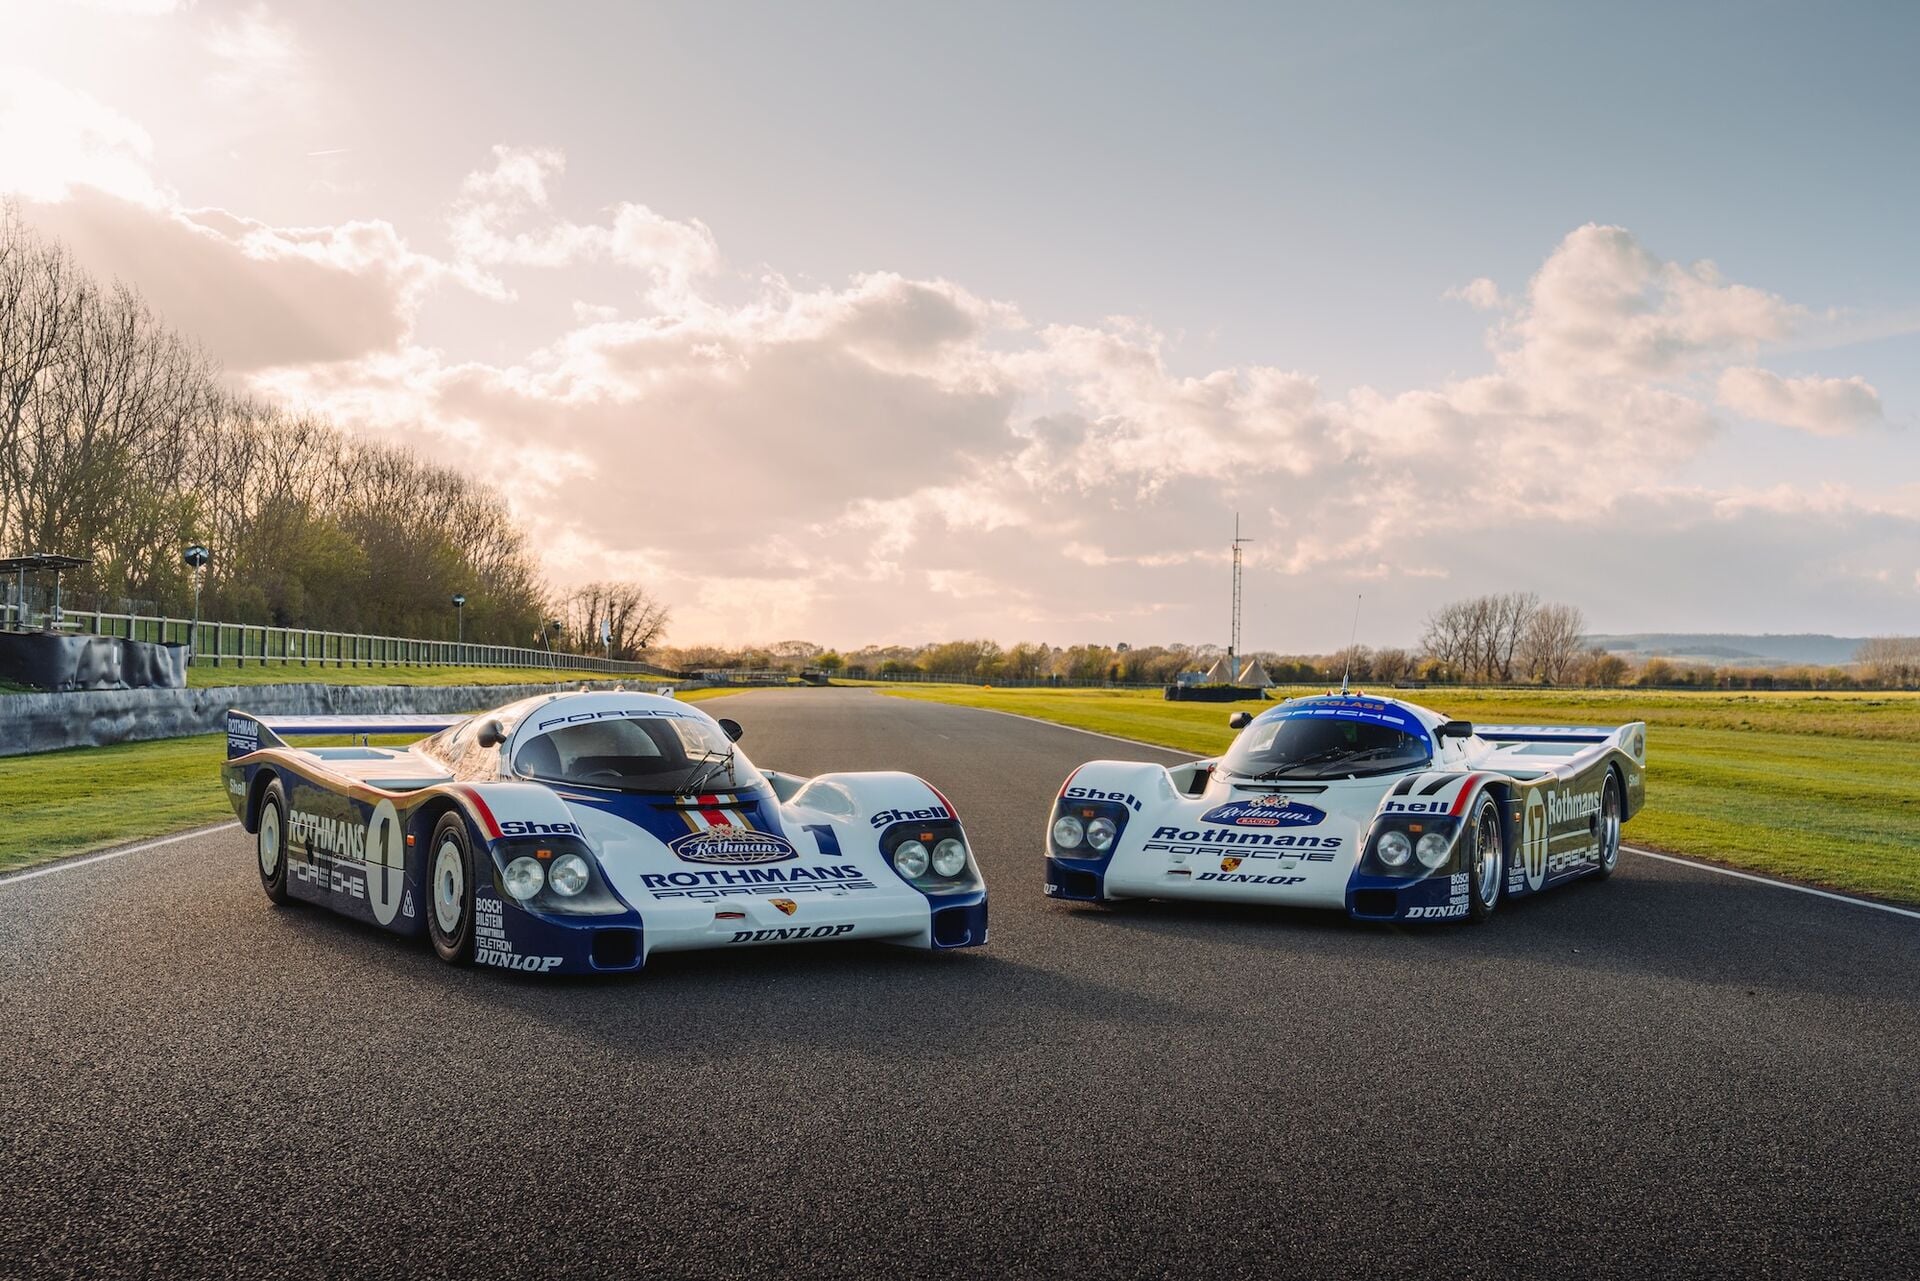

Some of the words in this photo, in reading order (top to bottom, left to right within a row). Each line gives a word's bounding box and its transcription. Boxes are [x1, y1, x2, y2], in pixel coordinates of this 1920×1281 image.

[228, 718, 258, 737] ROTHMANS
[539, 710, 709, 731] PORSCH
[228, 737, 257, 751] PORSCHE
[229, 778, 246, 796] Shell
[1067, 787, 1142, 812] Shell
[1385, 801, 1449, 813] hell
[1547, 787, 1600, 825] Rothmans
[870, 807, 950, 828] Shell
[1211, 806, 1312, 823] Rothmans
[289, 810, 365, 859] ROTHMANS
[500, 821, 580, 837] Shel
[1152, 826, 1343, 848] Rothmans
[689, 839, 780, 856] Rothmans
[802, 824, 843, 857] 1
[1528, 804, 1544, 877] 17
[379, 817, 390, 906] 1
[1142, 844, 1336, 862] PORSCHE
[1548, 843, 1599, 873] PORSCHE
[287, 857, 365, 899] PORSCHE
[640, 865, 863, 888] ROTHMANS
[1196, 872, 1307, 886] DUNLOP
[653, 881, 878, 900] PORSCHE
[475, 897, 503, 915] BOSCH
[1405, 903, 1469, 918] DUNLOP
[727, 924, 855, 944] DUNLOP
[474, 936, 512, 953] TELETRON
[474, 948, 564, 972] DUNLOP
